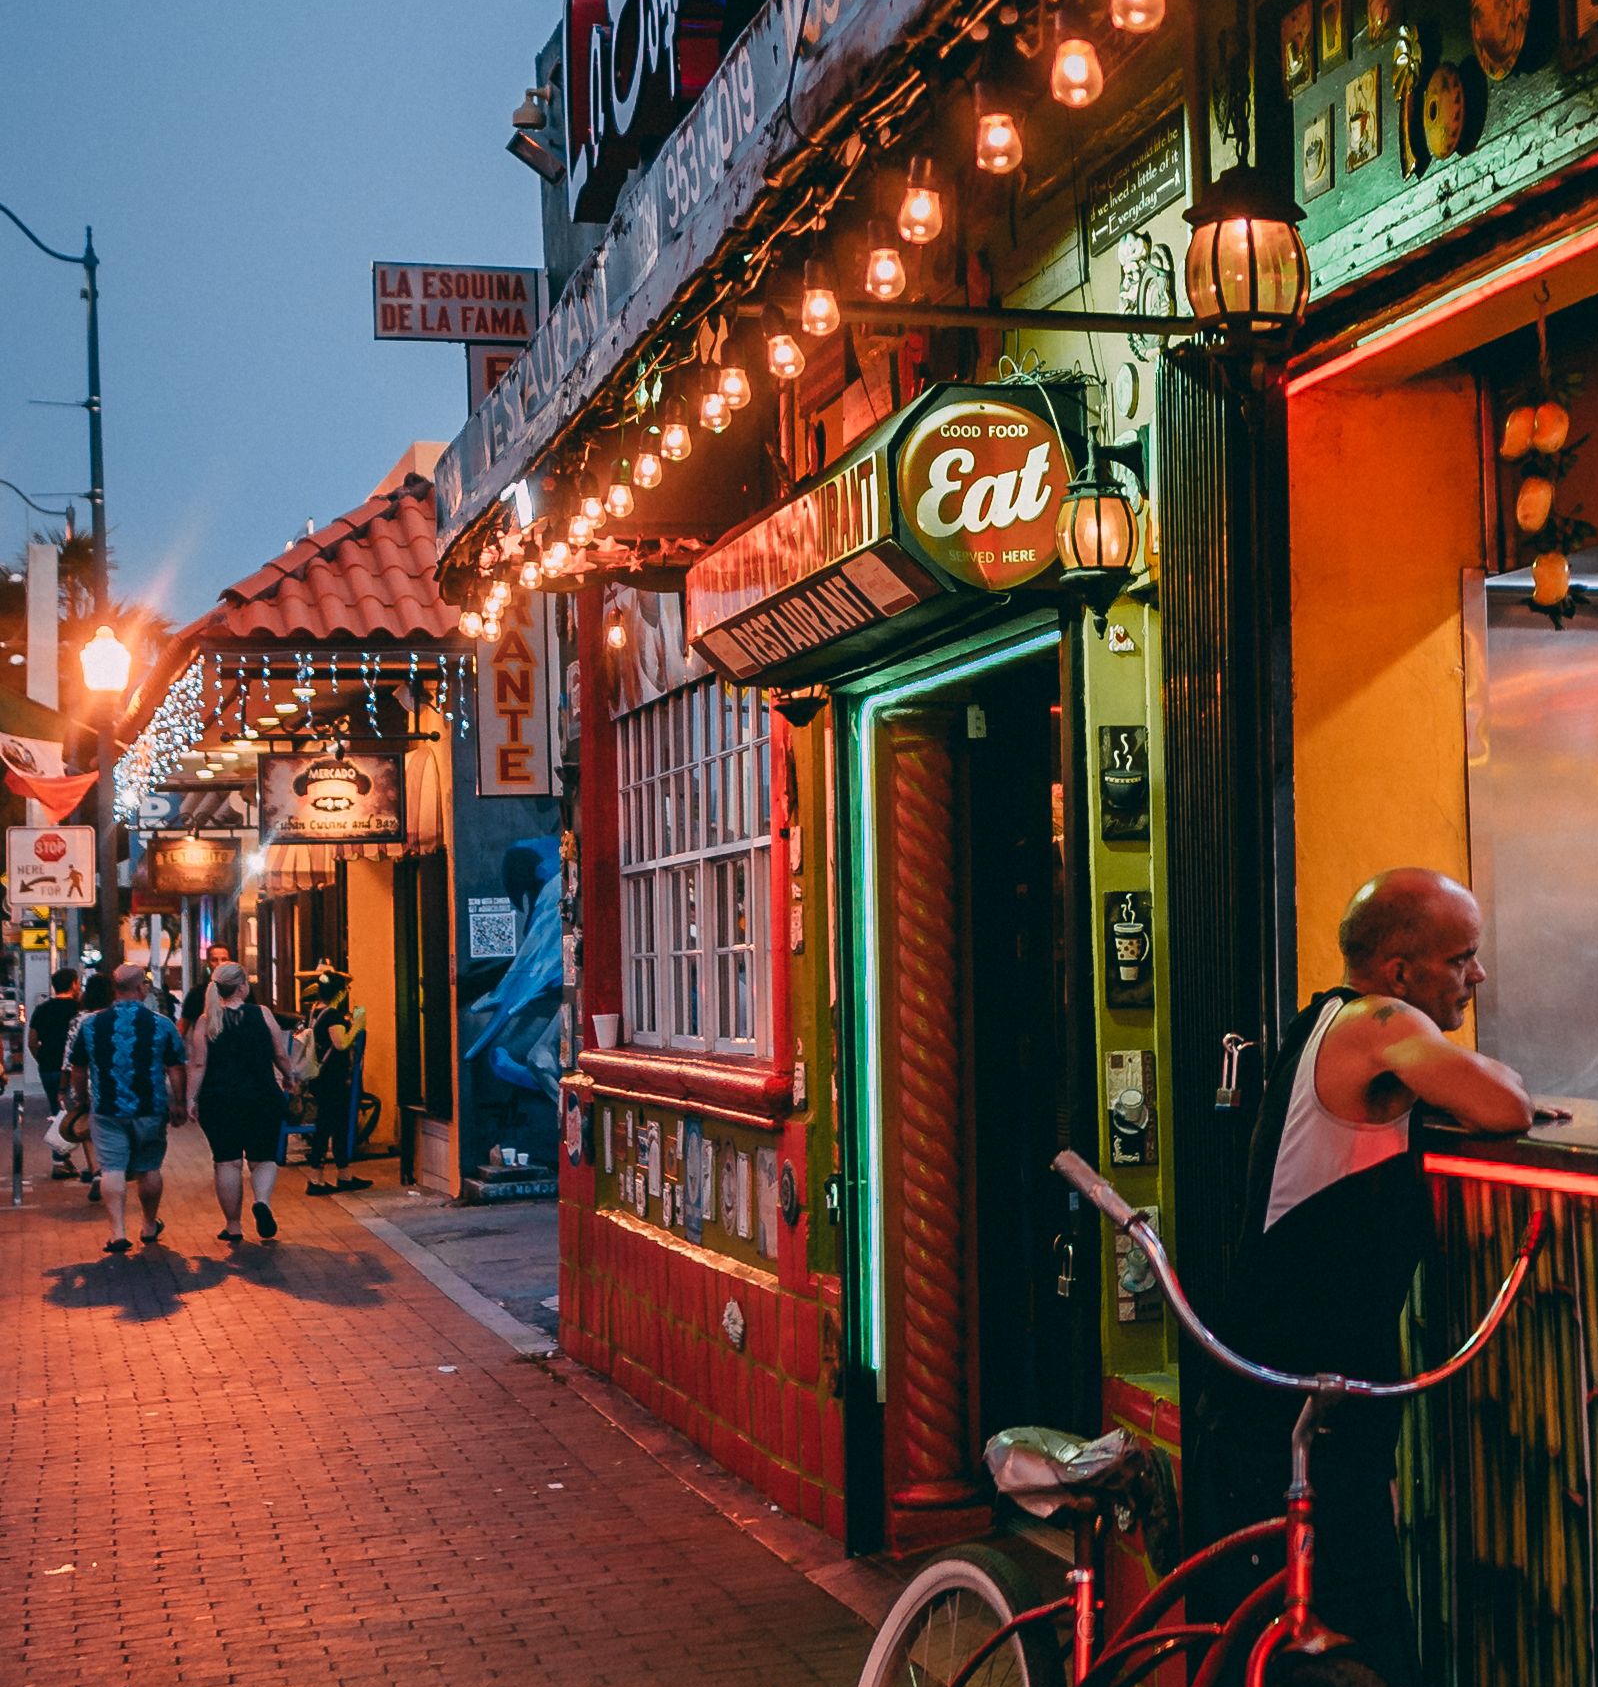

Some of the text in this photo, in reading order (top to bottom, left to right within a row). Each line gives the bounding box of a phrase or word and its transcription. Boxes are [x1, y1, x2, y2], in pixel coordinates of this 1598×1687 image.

[1167, 127, 1179, 143] be
[1097, 202, 1109, 217] we
[1109, 179, 1129, 208] lived
[1137, 162, 1158, 188] little
[1159, 149, 1171, 173] of
[1171, 149, 1179, 164] it
[1107, 190, 1158, 235] Everyday
[379, 269, 528, 303] LA ESQUINA
[379, 303, 530, 336] DE LA FAMA
[940, 423, 1029, 439] GOOD FOOD
[916, 441, 1052, 538] Eat
[949, 548, 1037, 564] SERVED HERE
[730, 574, 876, 666] RESTAURANT
[307, 767, 357, 780] MERCADO
[351, 814, 374, 829] and
[35, 840, 66, 855] STOP
[17, 865, 45, 876] HERE
[41, 885, 62, 896] FOR
